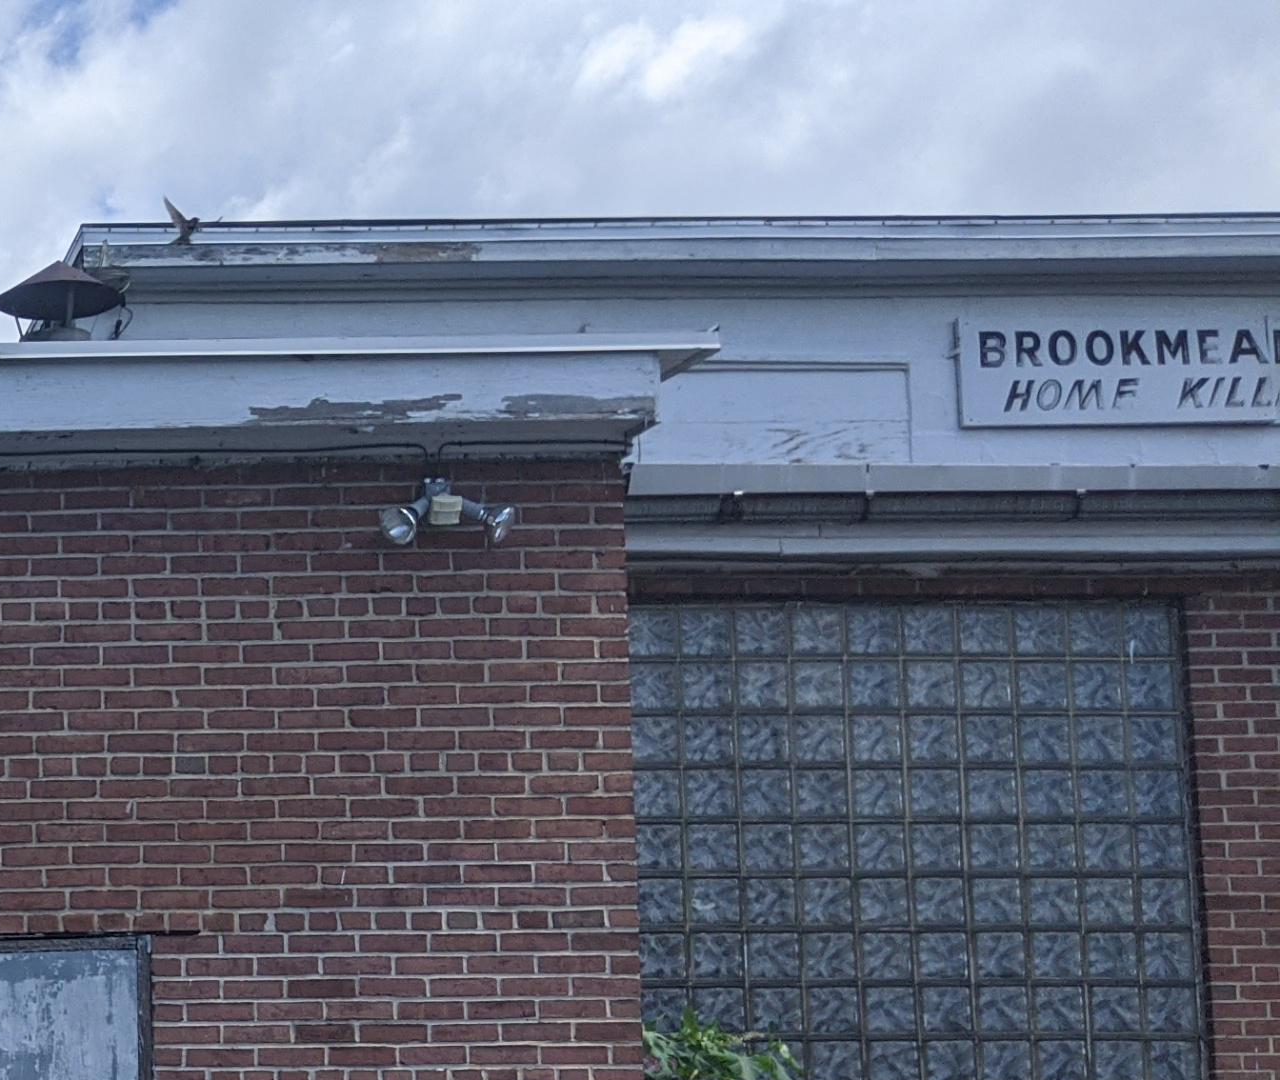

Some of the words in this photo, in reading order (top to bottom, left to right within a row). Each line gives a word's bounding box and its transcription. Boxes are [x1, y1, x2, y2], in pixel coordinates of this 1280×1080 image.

[978, 329, 1280, 369] BROOKMEA
[1004, 377, 1140, 412] HOME
[1177, 375, 1280, 409] KILL
